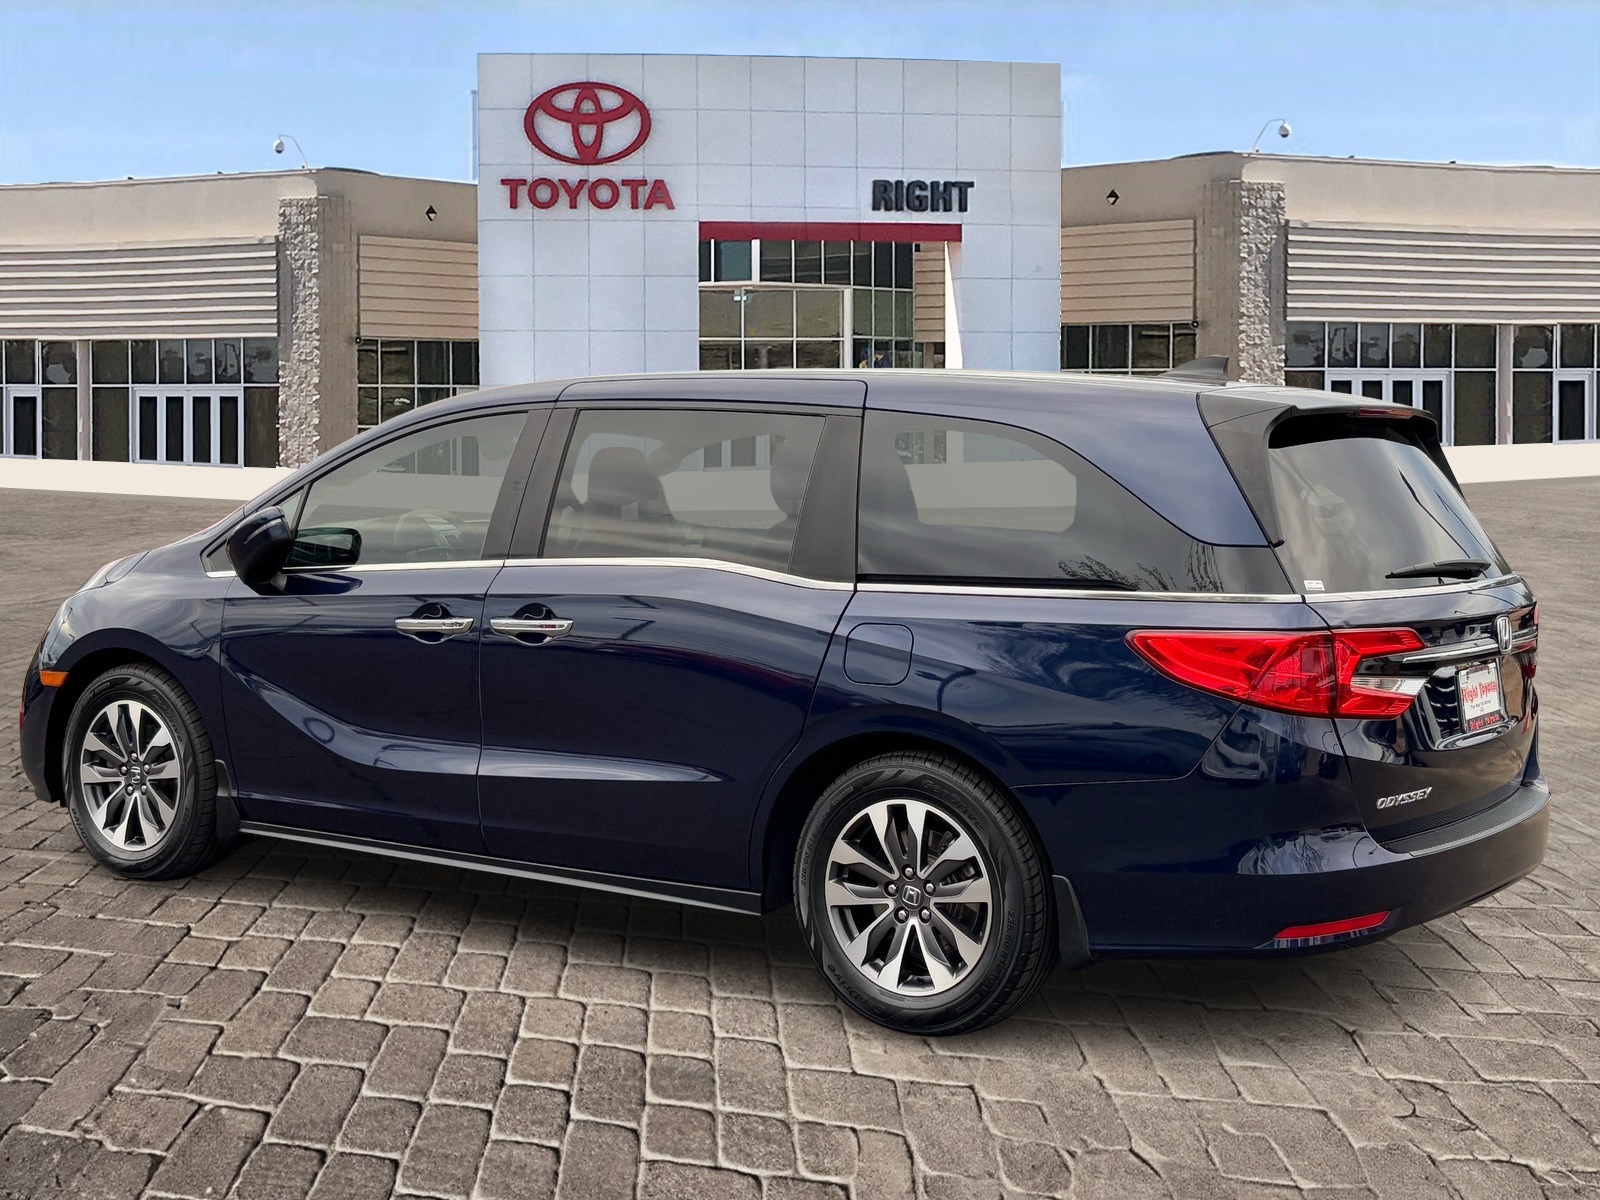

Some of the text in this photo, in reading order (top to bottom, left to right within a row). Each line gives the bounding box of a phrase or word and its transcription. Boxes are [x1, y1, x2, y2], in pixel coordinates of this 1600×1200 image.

[500, 178, 675, 210] TOYOTA
[872, 179, 975, 212] RIGHT
[1479, 681, 1498, 699] Toyota
[1376, 786, 1432, 809] ODYSSEY
